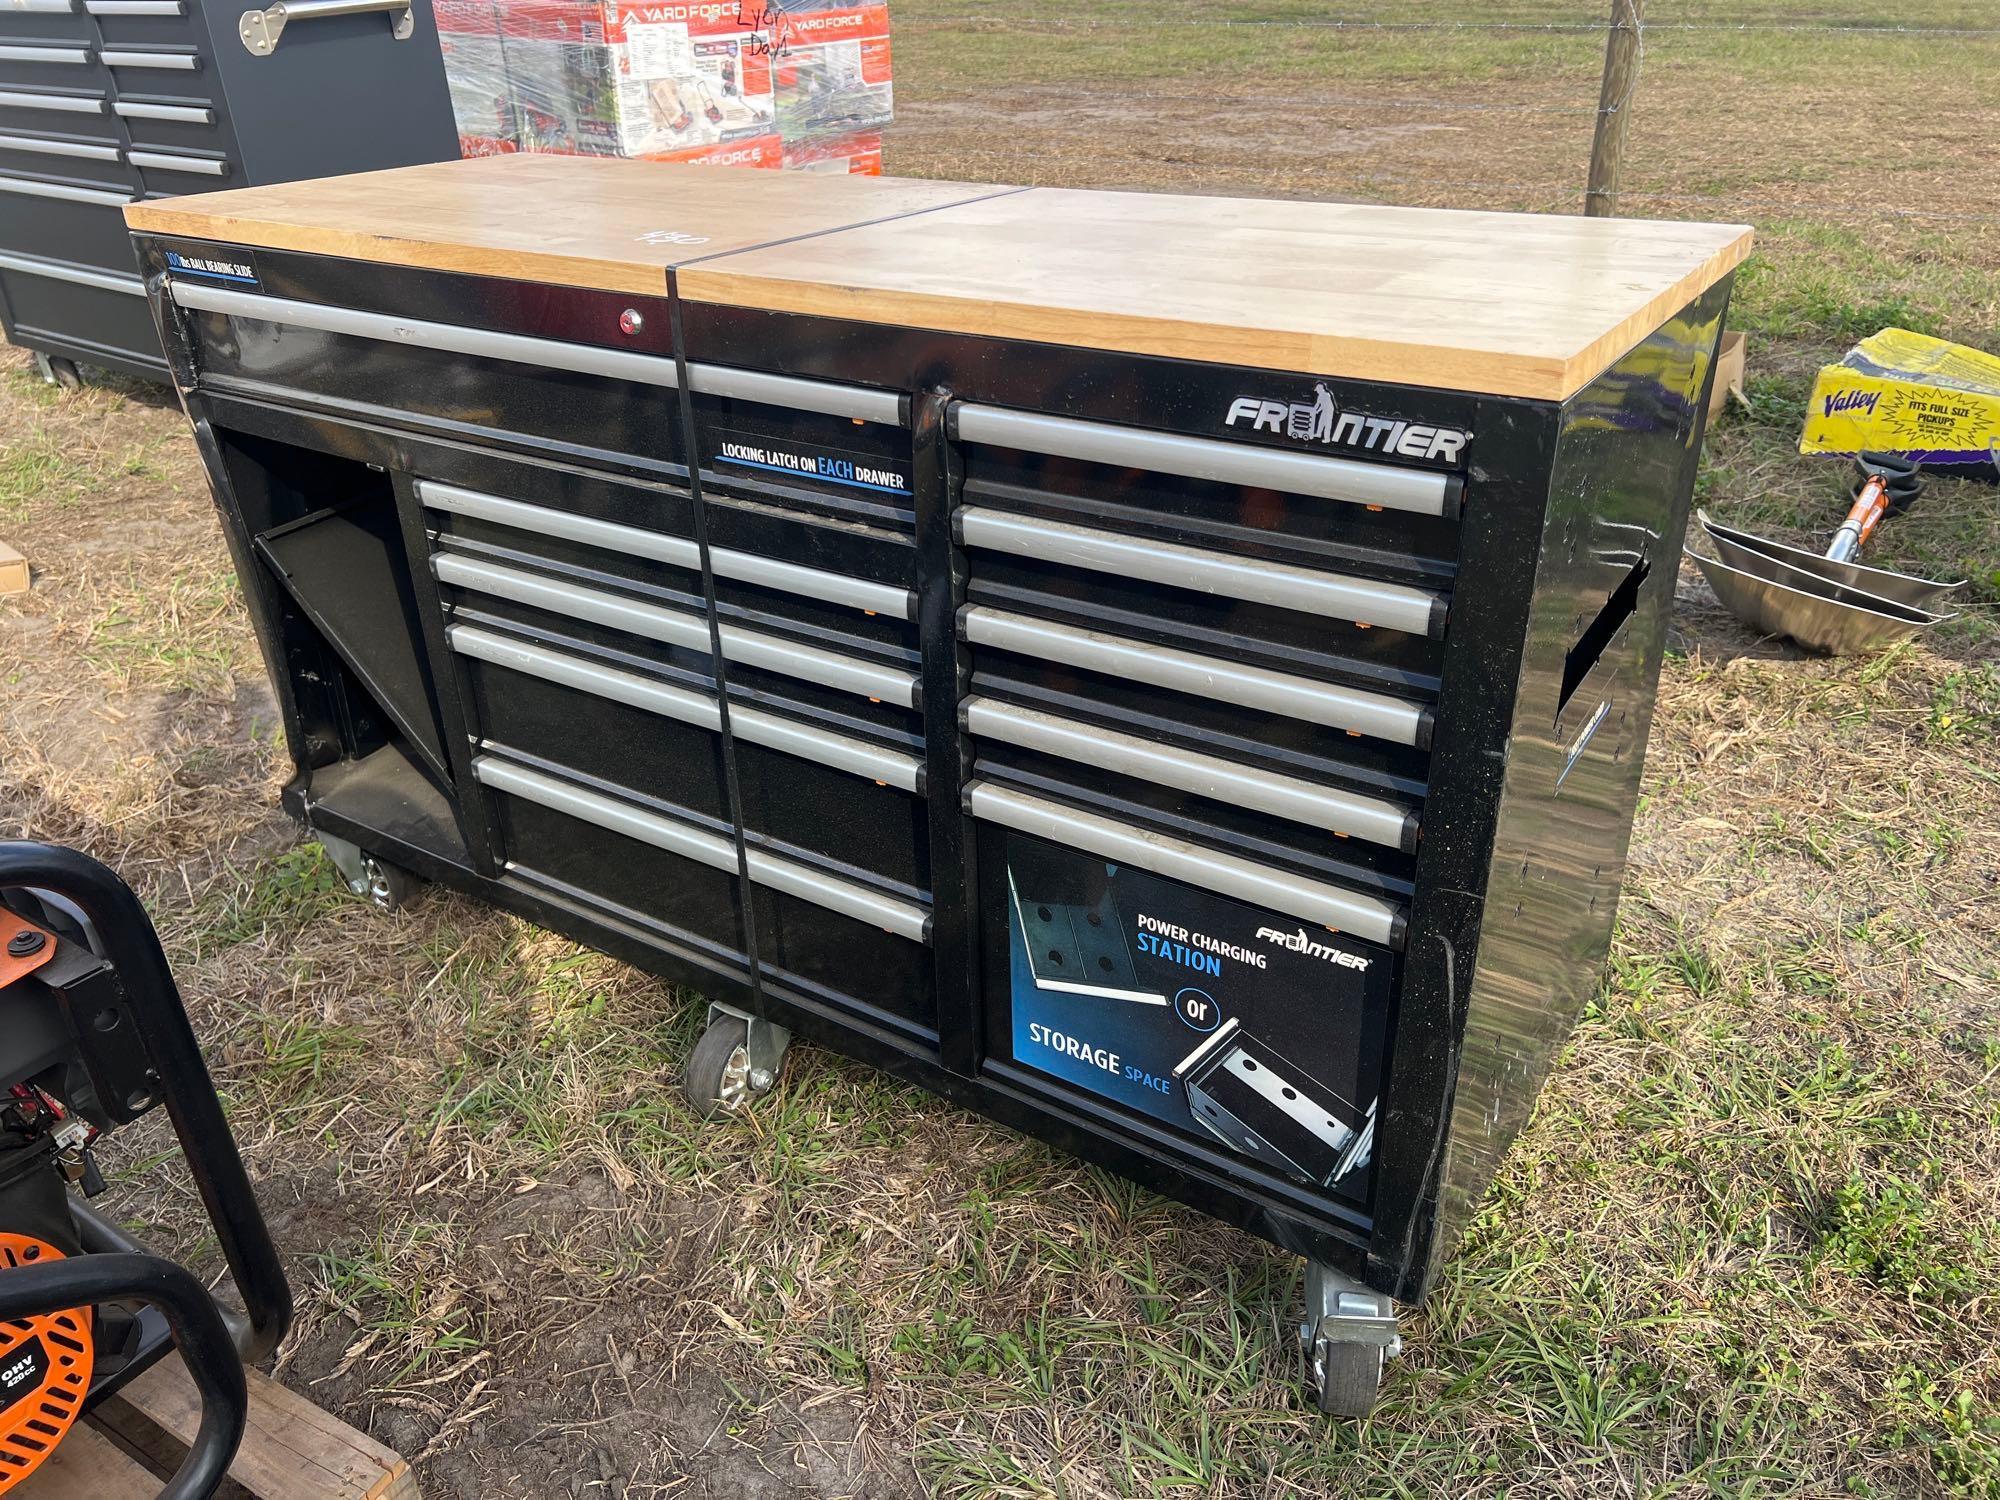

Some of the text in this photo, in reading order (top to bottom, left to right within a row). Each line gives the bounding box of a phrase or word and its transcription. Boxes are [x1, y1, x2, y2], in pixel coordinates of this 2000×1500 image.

[642, 3, 741, 21] YARD FORCE
[796, 15, 863, 31] YARD FORCE
[189, 257, 207, 271] BALL
[206, 260, 235, 275] BEARING
[233, 264, 254, 278] SLIDE
[1824, 390, 1882, 418] Valley
[1908, 401, 1971, 418] FITS FULL SIZE
[1917, 413, 1956, 426] PICKUPS
[722, 442, 905, 489] LOCKING LATCH ON EACH DRAWER
[1138, 913, 1267, 969] POWER CHARGING
[1137, 932, 1221, 977] STATION
[1187, 999, 1208, 1021] or
[1029, 1022, 1170, 1095] STORAGE SPACE
[1, 1354, 32, 1382] OHV
